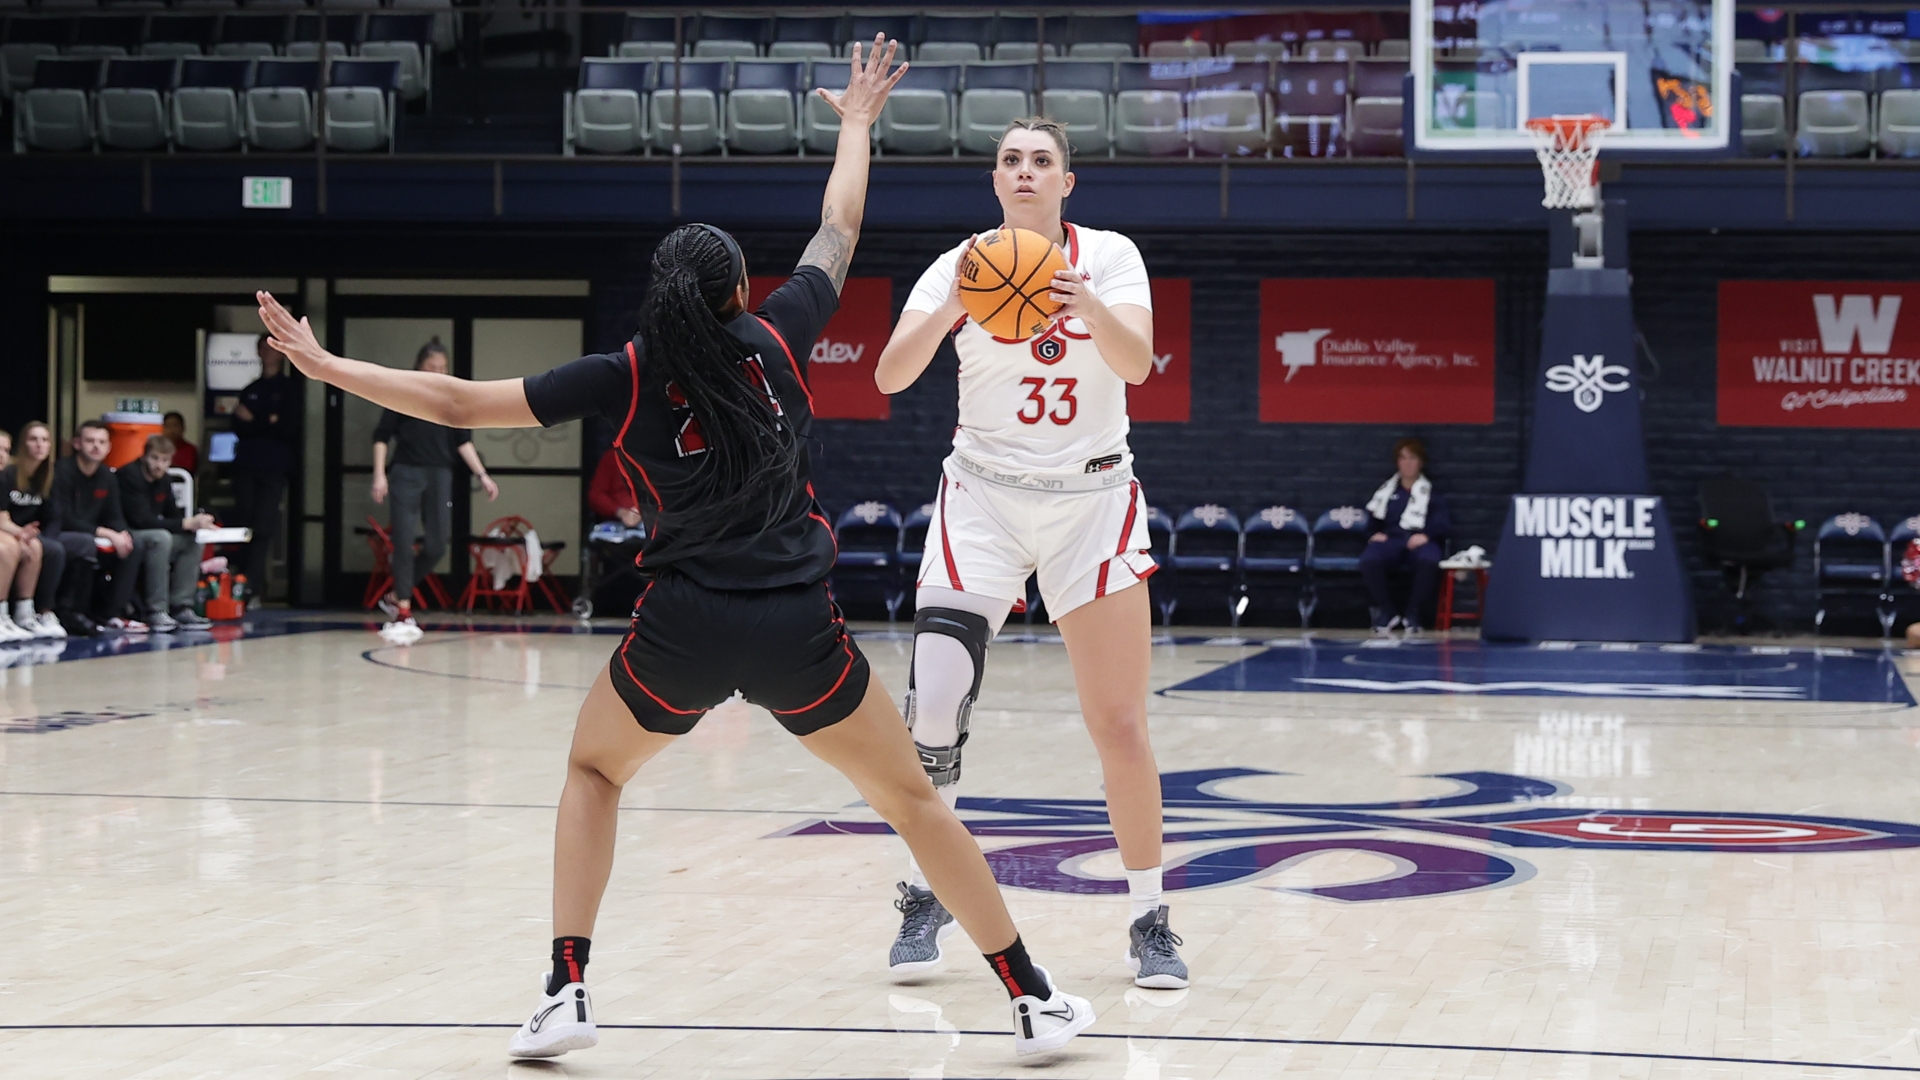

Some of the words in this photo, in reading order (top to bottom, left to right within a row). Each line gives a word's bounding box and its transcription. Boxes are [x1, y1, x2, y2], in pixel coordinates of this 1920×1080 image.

[1812, 293, 1902, 354] W
[812, 337, 864, 363] dev
[1321, 339, 1370, 352] Diablo
[1373, 339, 1417, 354] Valley
[1779, 338, 1818, 352] VISIT
[1321, 353, 1387, 366] Insurance
[1391, 353, 1448, 369] Agency,
[1453, 353, 1479, 366] Inc.
[1752, 356, 1846, 384] WALNUT
[1850, 357, 1920, 386] CREEK
[1017, 376, 1078, 426] 33
[1514, 496, 1656, 538] MUSCLE
